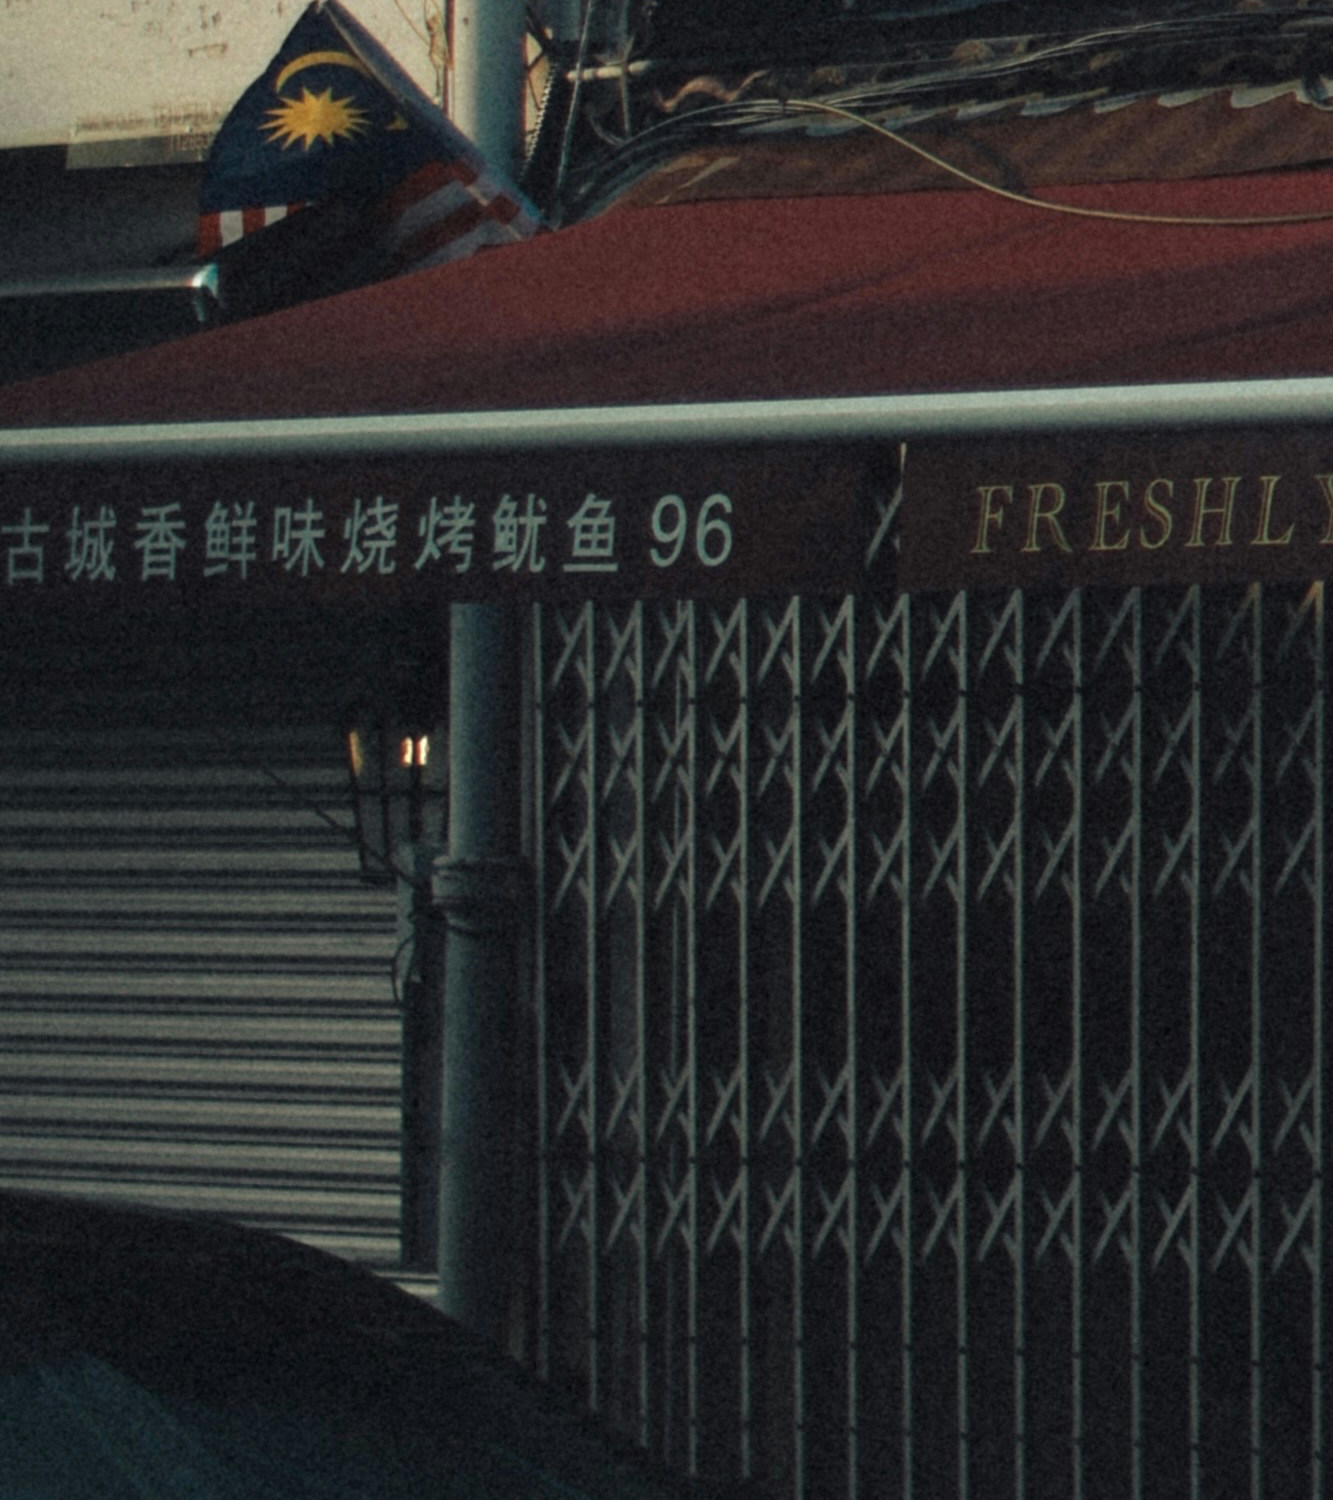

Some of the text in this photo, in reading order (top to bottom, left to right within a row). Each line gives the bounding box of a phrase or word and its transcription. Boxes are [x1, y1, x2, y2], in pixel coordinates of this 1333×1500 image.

[3, 491, 734, 586] 古城香鲜味烧烤鱿鱼 96
